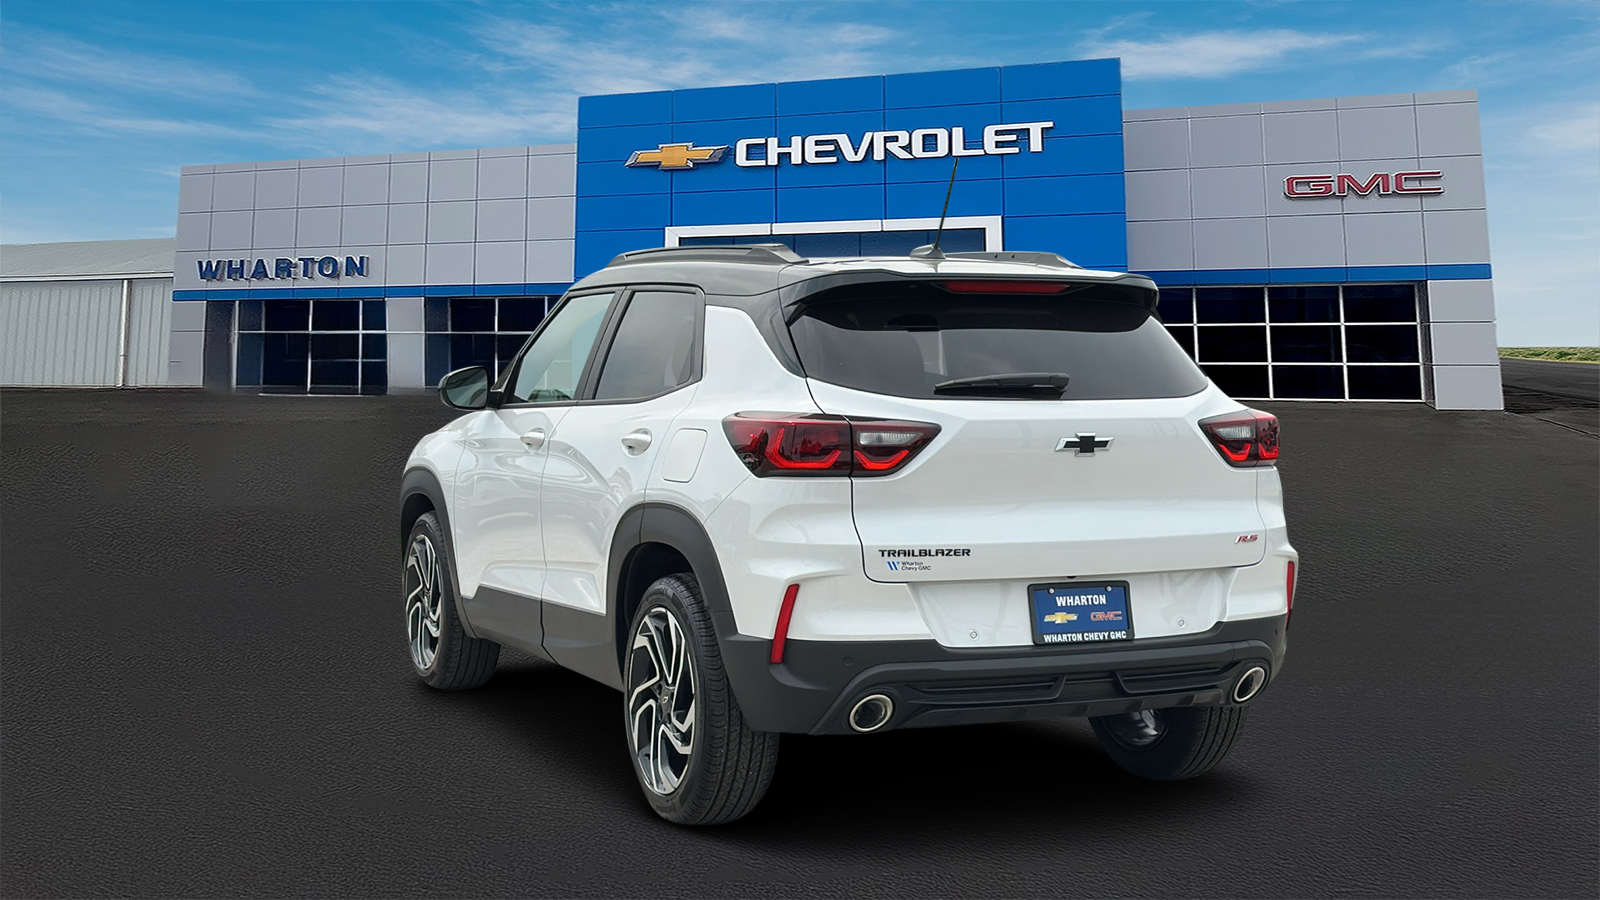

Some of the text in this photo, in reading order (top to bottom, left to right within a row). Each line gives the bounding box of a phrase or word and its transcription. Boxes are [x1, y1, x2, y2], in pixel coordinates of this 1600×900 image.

[734, 121, 1054, 168] CHEVROLET
[1283, 170, 1444, 198] GMC
[197, 255, 369, 281] WHARTON
[1235, 535, 1258, 544] RS
[878, 549, 971, 557] TRAILBLAZER
[1056, 595, 1107, 607] WHARTON
[1090, 611, 1122, 622] GMC
[1043, 631, 1127, 643] WHARTON CHEVY GMC
